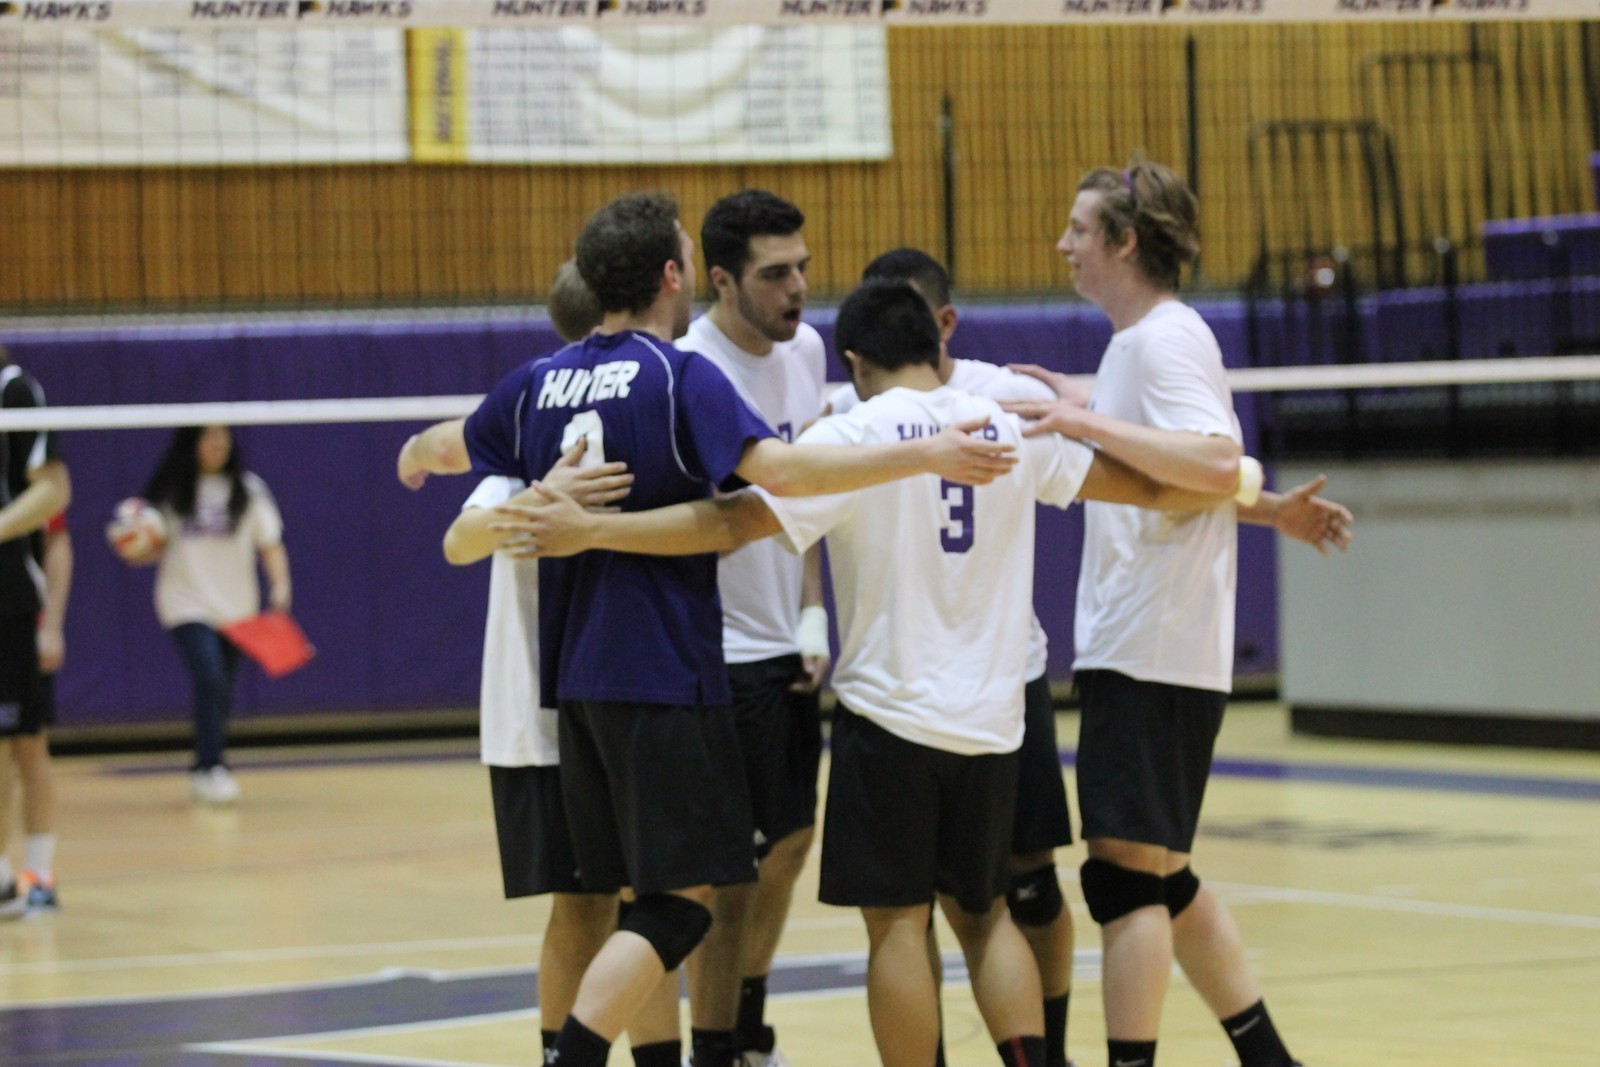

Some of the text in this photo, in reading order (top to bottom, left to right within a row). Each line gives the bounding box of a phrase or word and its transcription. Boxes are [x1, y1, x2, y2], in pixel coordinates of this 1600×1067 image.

[23, 1, 112, 20] HAWKS
[190, 0, 413, 18] HUNTER HAWKS
[492, 0, 706, 17] HUNTER HAWKS
[780, 0, 873, 16] HUNTER
[940, 476, 975, 553] 3
